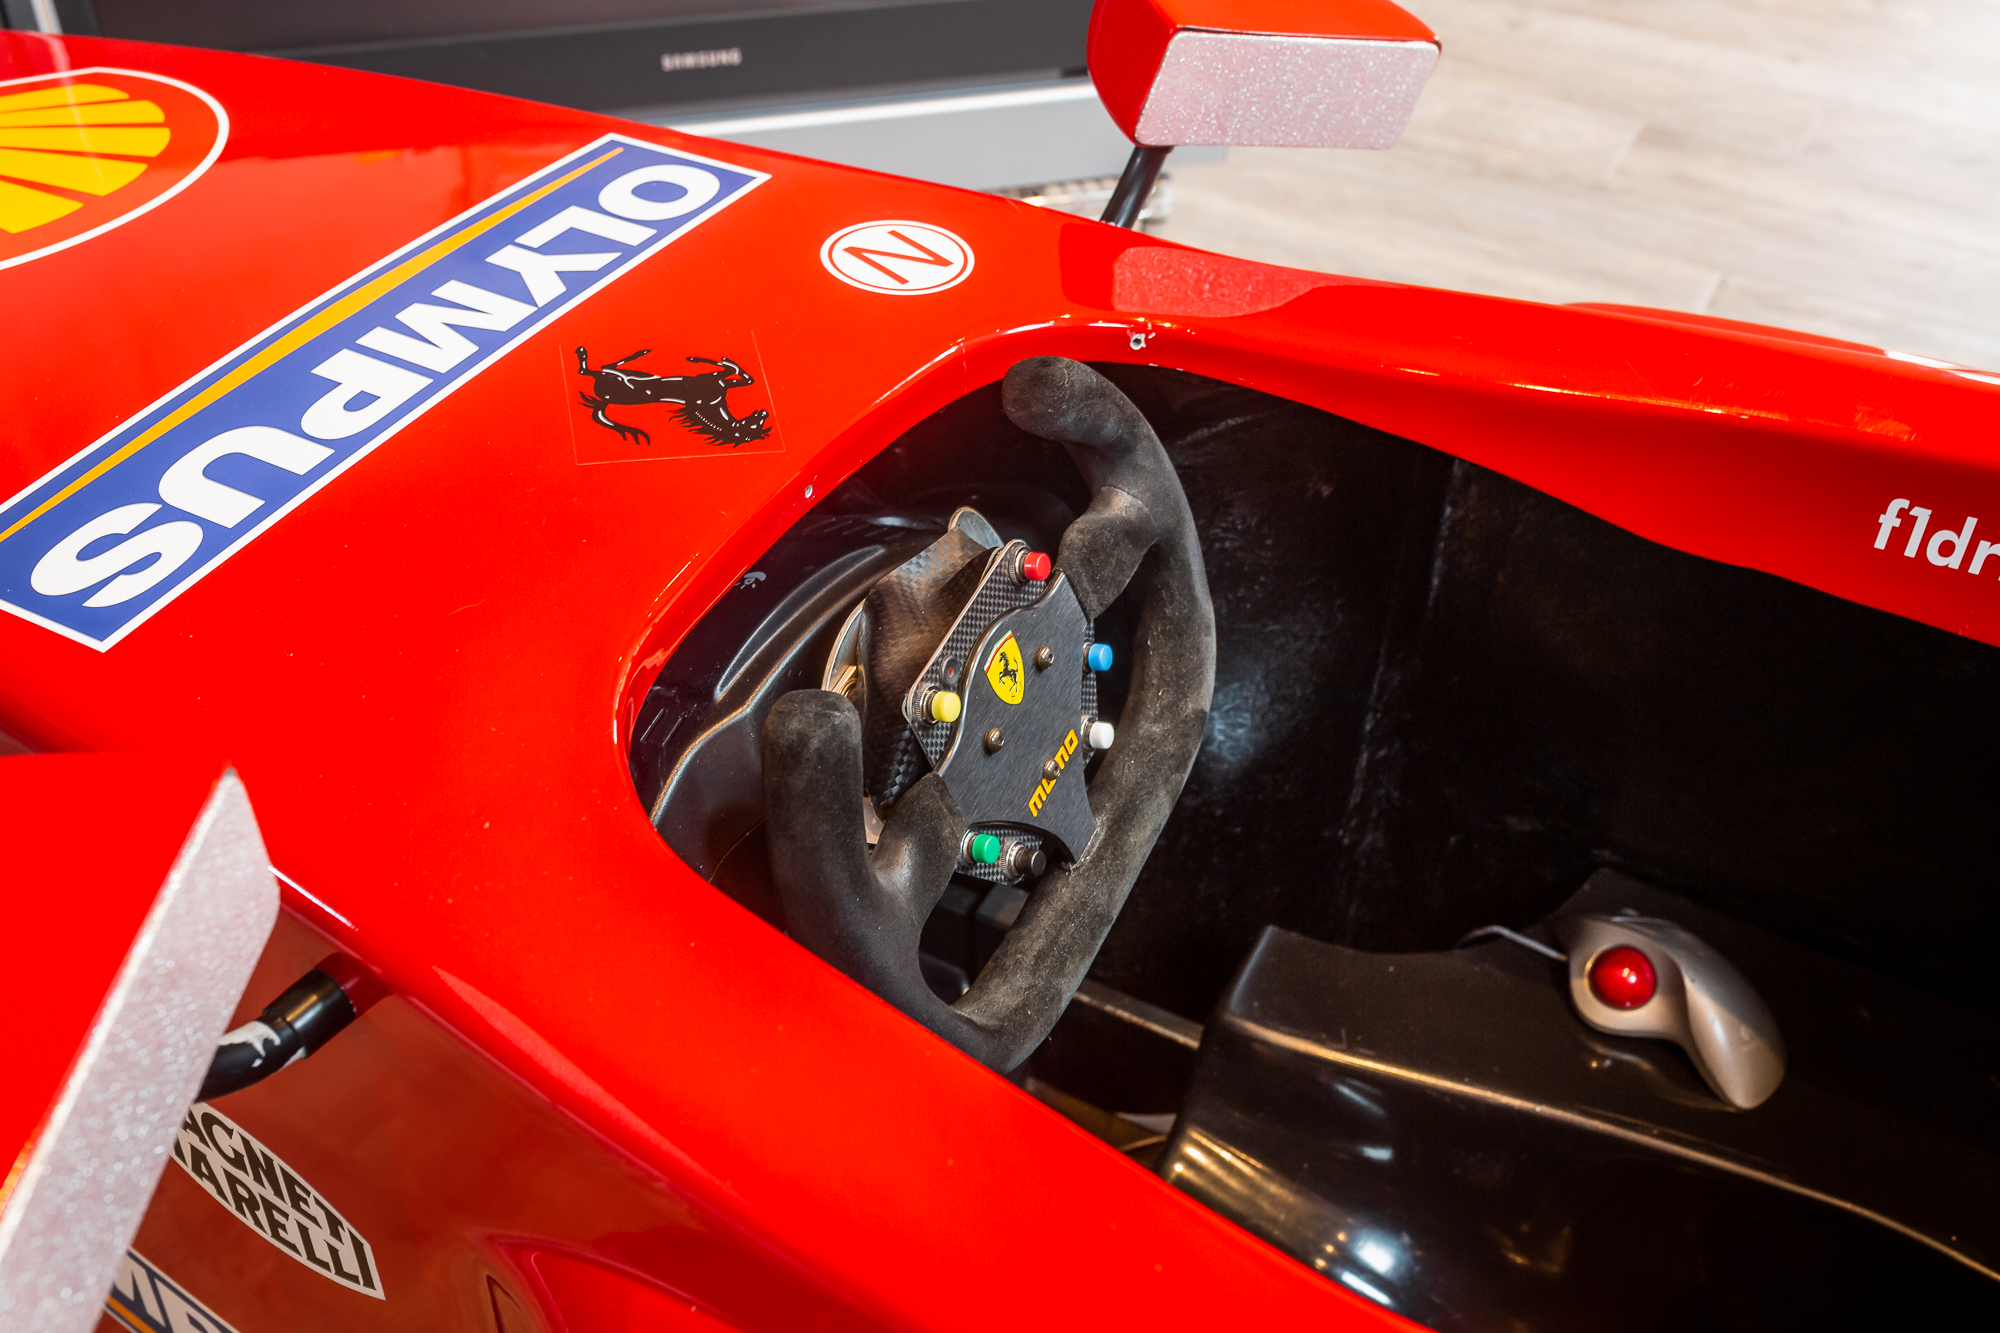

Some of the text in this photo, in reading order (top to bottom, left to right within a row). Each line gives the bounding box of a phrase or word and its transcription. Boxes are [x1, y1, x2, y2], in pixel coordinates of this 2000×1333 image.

[661, 47, 742, 72] SAMSUNG
[30, 164, 721, 608] OLYMPUS
[1873, 498, 2000, 581] f1dr
[174, 1136, 377, 1291] ARELLI
[179, 1108, 377, 1291] AGNETI
